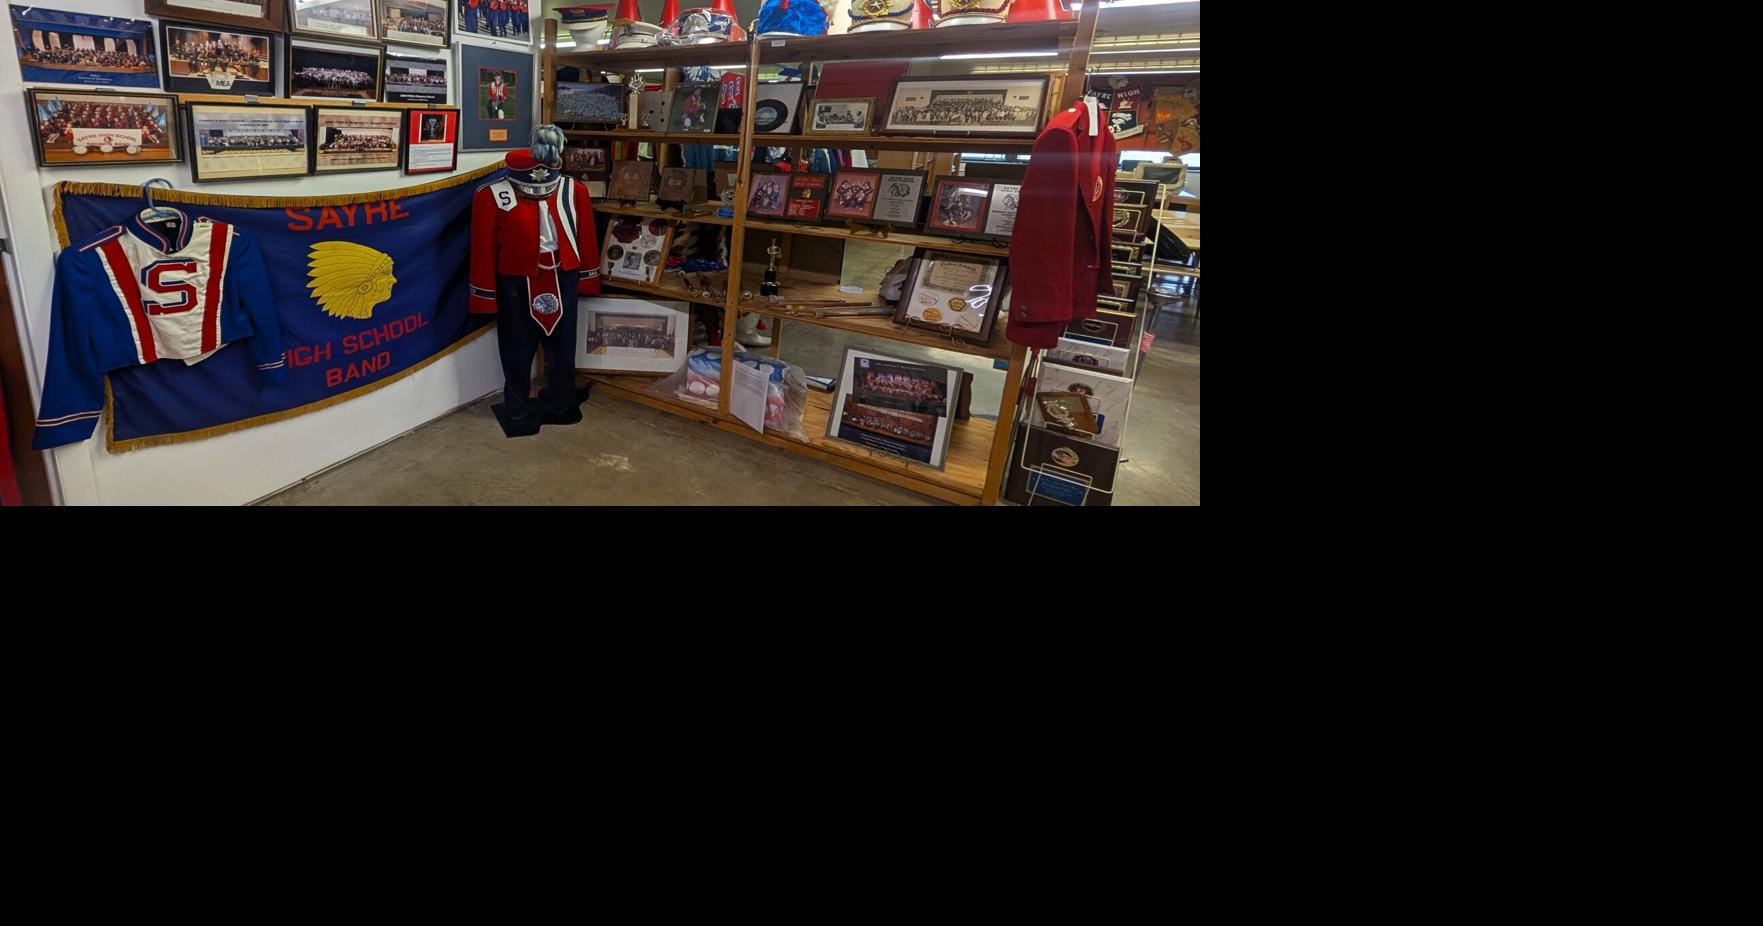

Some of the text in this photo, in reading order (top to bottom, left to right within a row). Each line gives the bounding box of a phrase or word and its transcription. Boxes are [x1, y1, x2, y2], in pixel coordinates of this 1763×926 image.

[1117, 89, 1141, 99] HIGH
[498, 190, 512, 206] S
[286, 200, 410, 232] SAYRE
[142, 259, 199, 316] S
[283, 312, 429, 368] IGH SCHOOL
[326, 351, 391, 388] BAND
